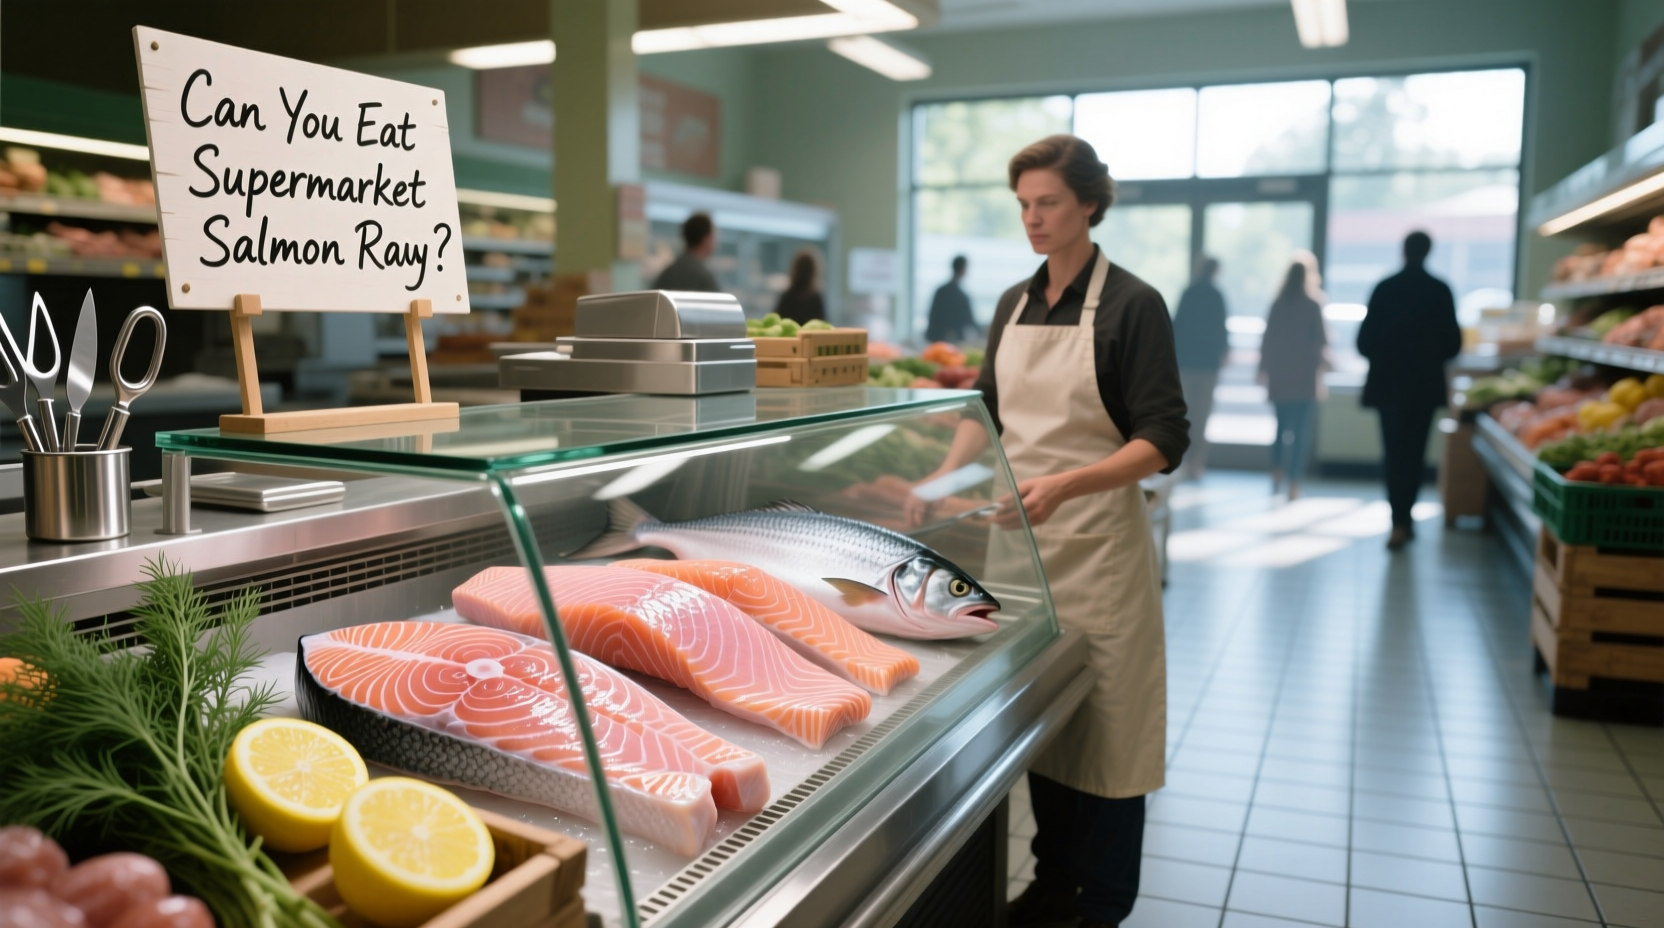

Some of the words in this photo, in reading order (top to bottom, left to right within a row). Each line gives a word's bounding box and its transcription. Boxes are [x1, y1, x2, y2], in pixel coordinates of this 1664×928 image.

[180, 68, 267, 131] Can
[279, 86, 343, 144] You
[356, 101, 417, 151] Eat
[188, 143, 427, 218] Supermarket
[199, 214, 345, 268] Salmon
